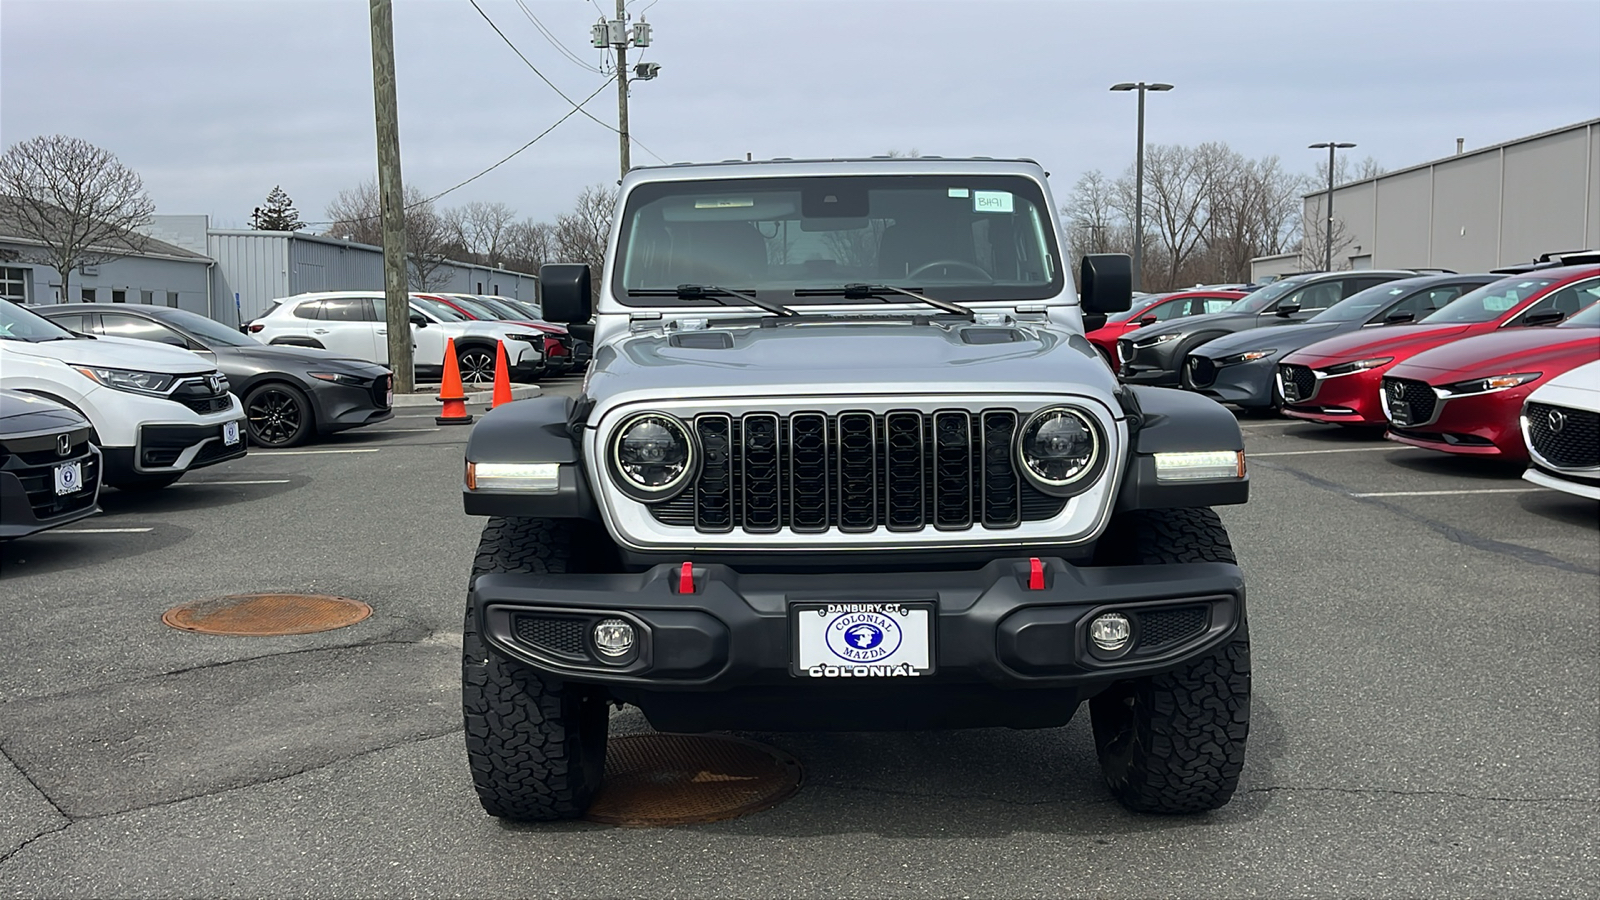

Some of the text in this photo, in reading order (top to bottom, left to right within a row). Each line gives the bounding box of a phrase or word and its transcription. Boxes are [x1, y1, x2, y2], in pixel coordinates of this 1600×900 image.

[828, 604, 901, 613] DANBURY, CT
[835, 614, 893, 632] COLONIAL
[842, 646, 887, 660] MAZDA
[809, 665, 920, 678] COLONIAL
